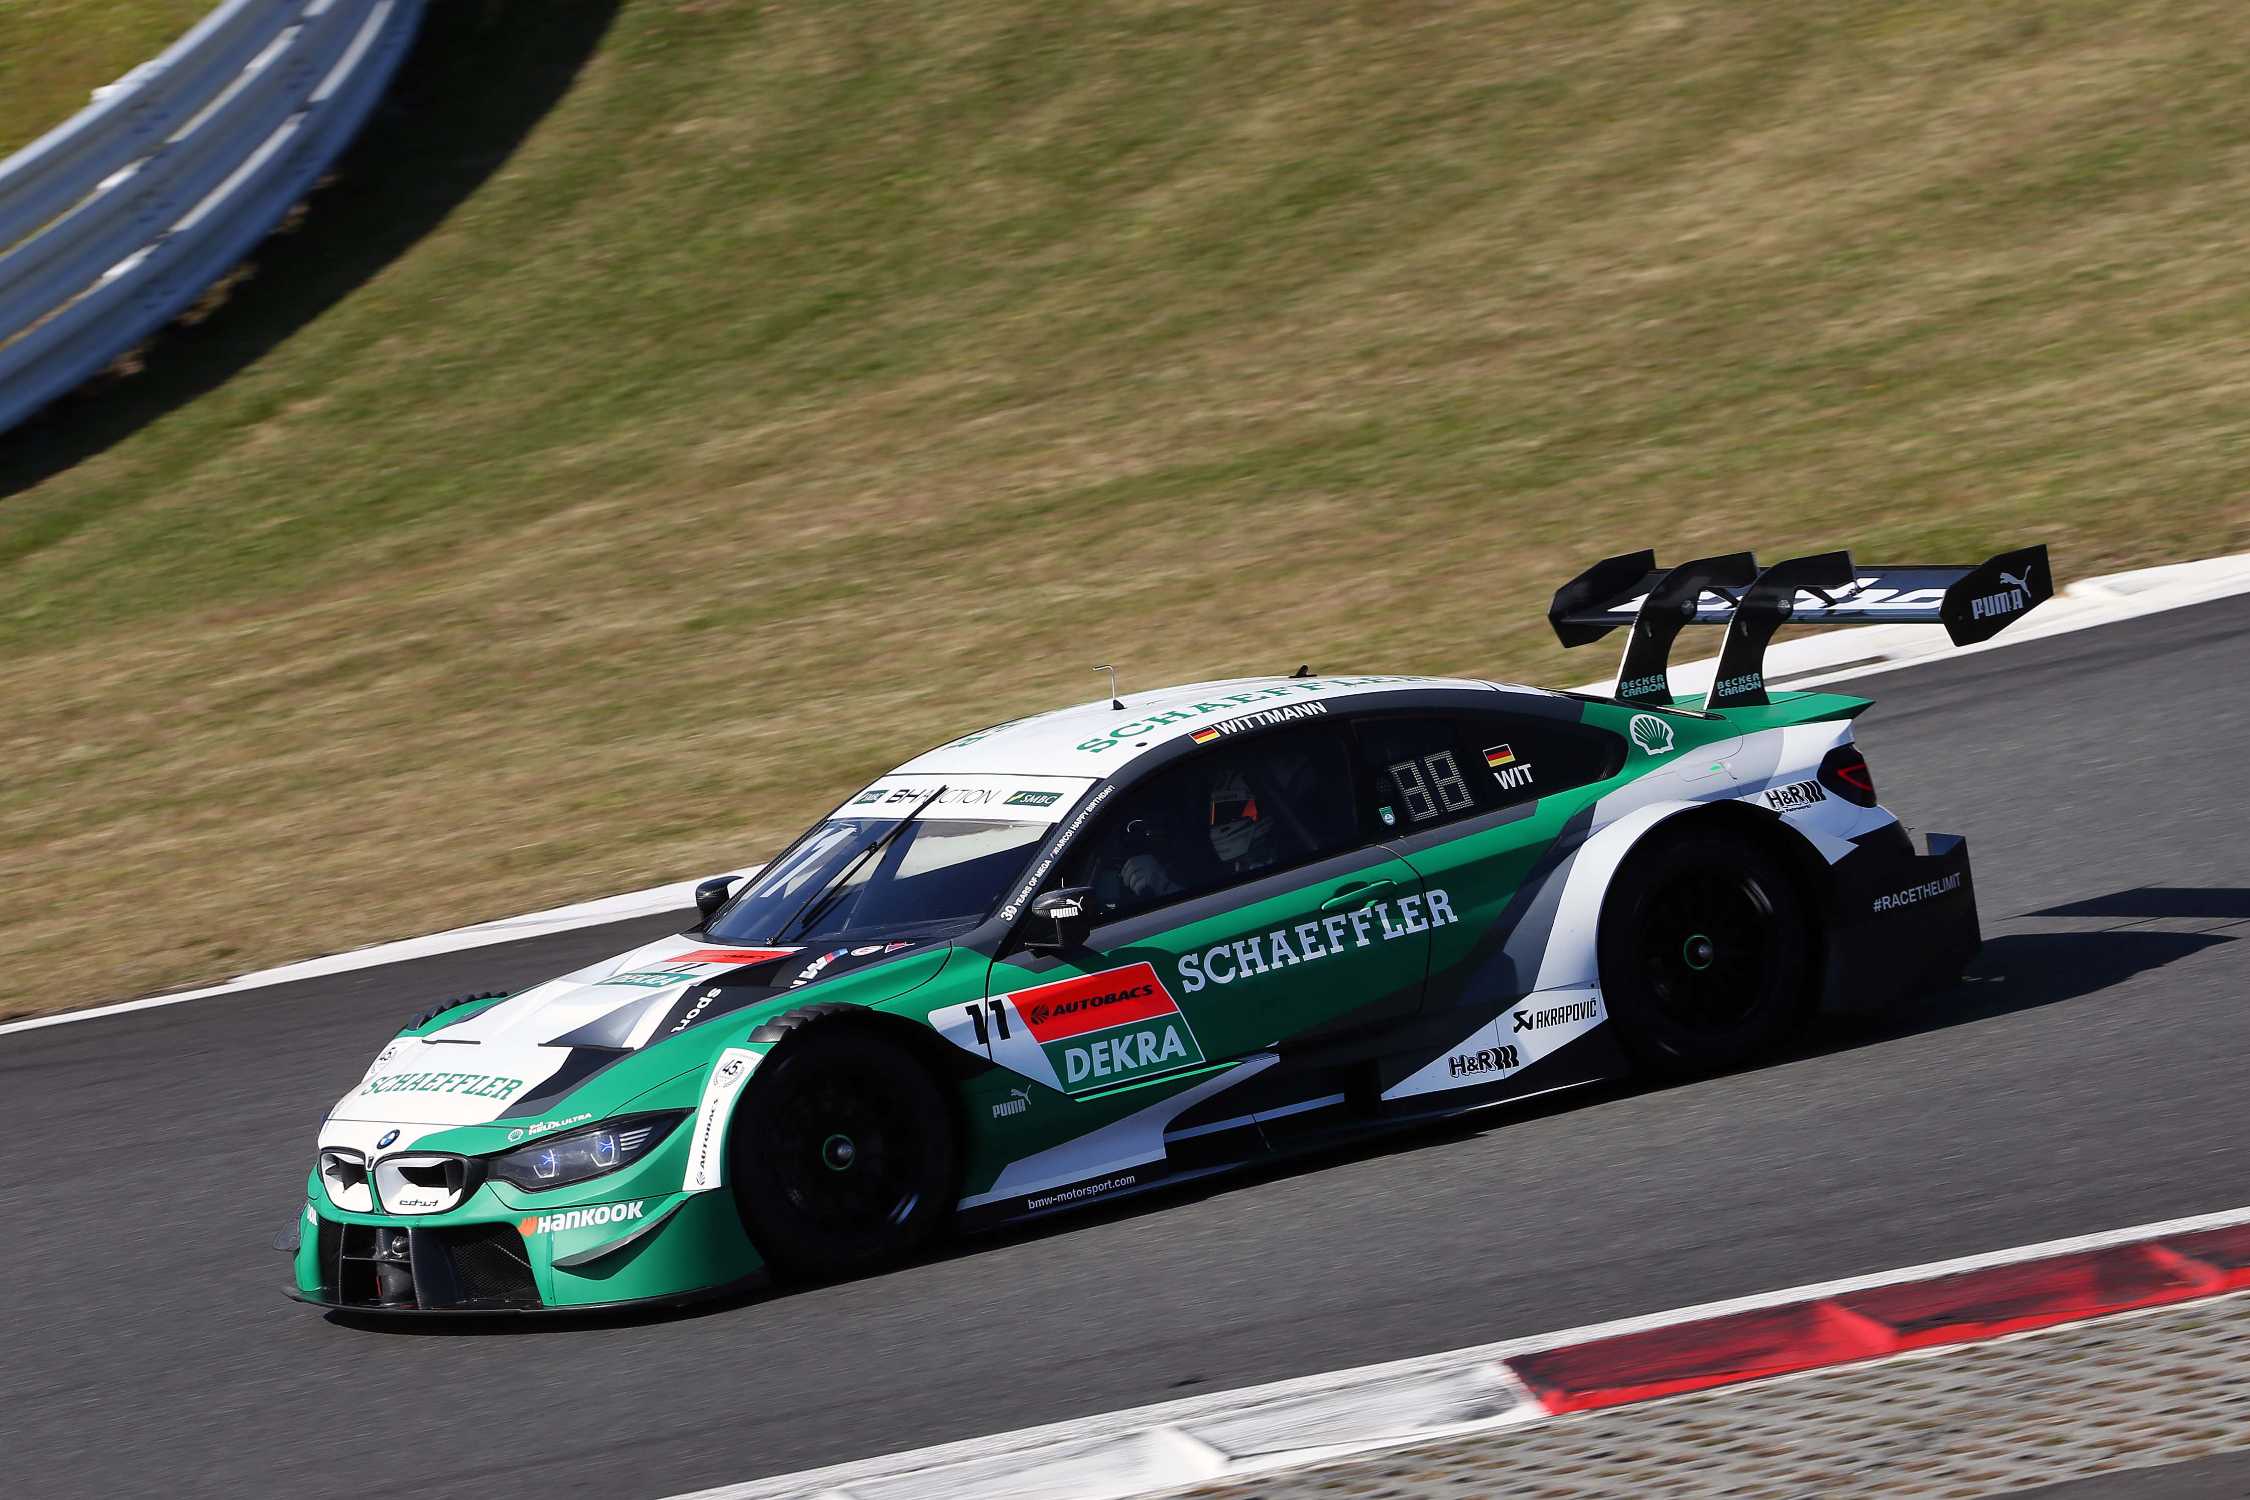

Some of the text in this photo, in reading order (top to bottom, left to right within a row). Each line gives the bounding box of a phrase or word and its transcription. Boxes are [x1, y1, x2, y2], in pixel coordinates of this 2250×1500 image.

[1972, 590, 2024, 620] PUMA
[1621, 674, 1664, 690] BECKER
[1622, 682, 1666, 698] CARBON
[1717, 672, 1760, 690] BECKER
[1718, 681, 1762, 697] CARBON
[1214, 701, 1328, 736] WITTMANN
[1494, 763, 1534, 790] WIT
[1000, 904, 1018, 921] 30
[1014, 885, 1033, 907] YEARS
[1028, 876, 1039, 887] OF
[1034, 859, 1053, 878] MEGA
[1071, 812, 1090, 831] HAPPY
[1872, 872, 1961, 912] #RACETHELIMIT
[1050, 906, 1079, 919] PUMA
[1177, 889, 1459, 993] SCHAEFFLER
[1052, 984, 1153, 1017] AUTOBACS
[965, 999, 1011, 1045] 11
[1065, 1025, 1187, 1084] DEKRA
[1448, 1050, 1495, 1078] H&R
[360, 1072, 524, 1101] SCHAEFFLER
[992, 1099, 1026, 1119] PUMA
[1027, 1174, 1136, 1210] bmw-motorsport.com
[536, 1200, 644, 1235] HANKOOK
